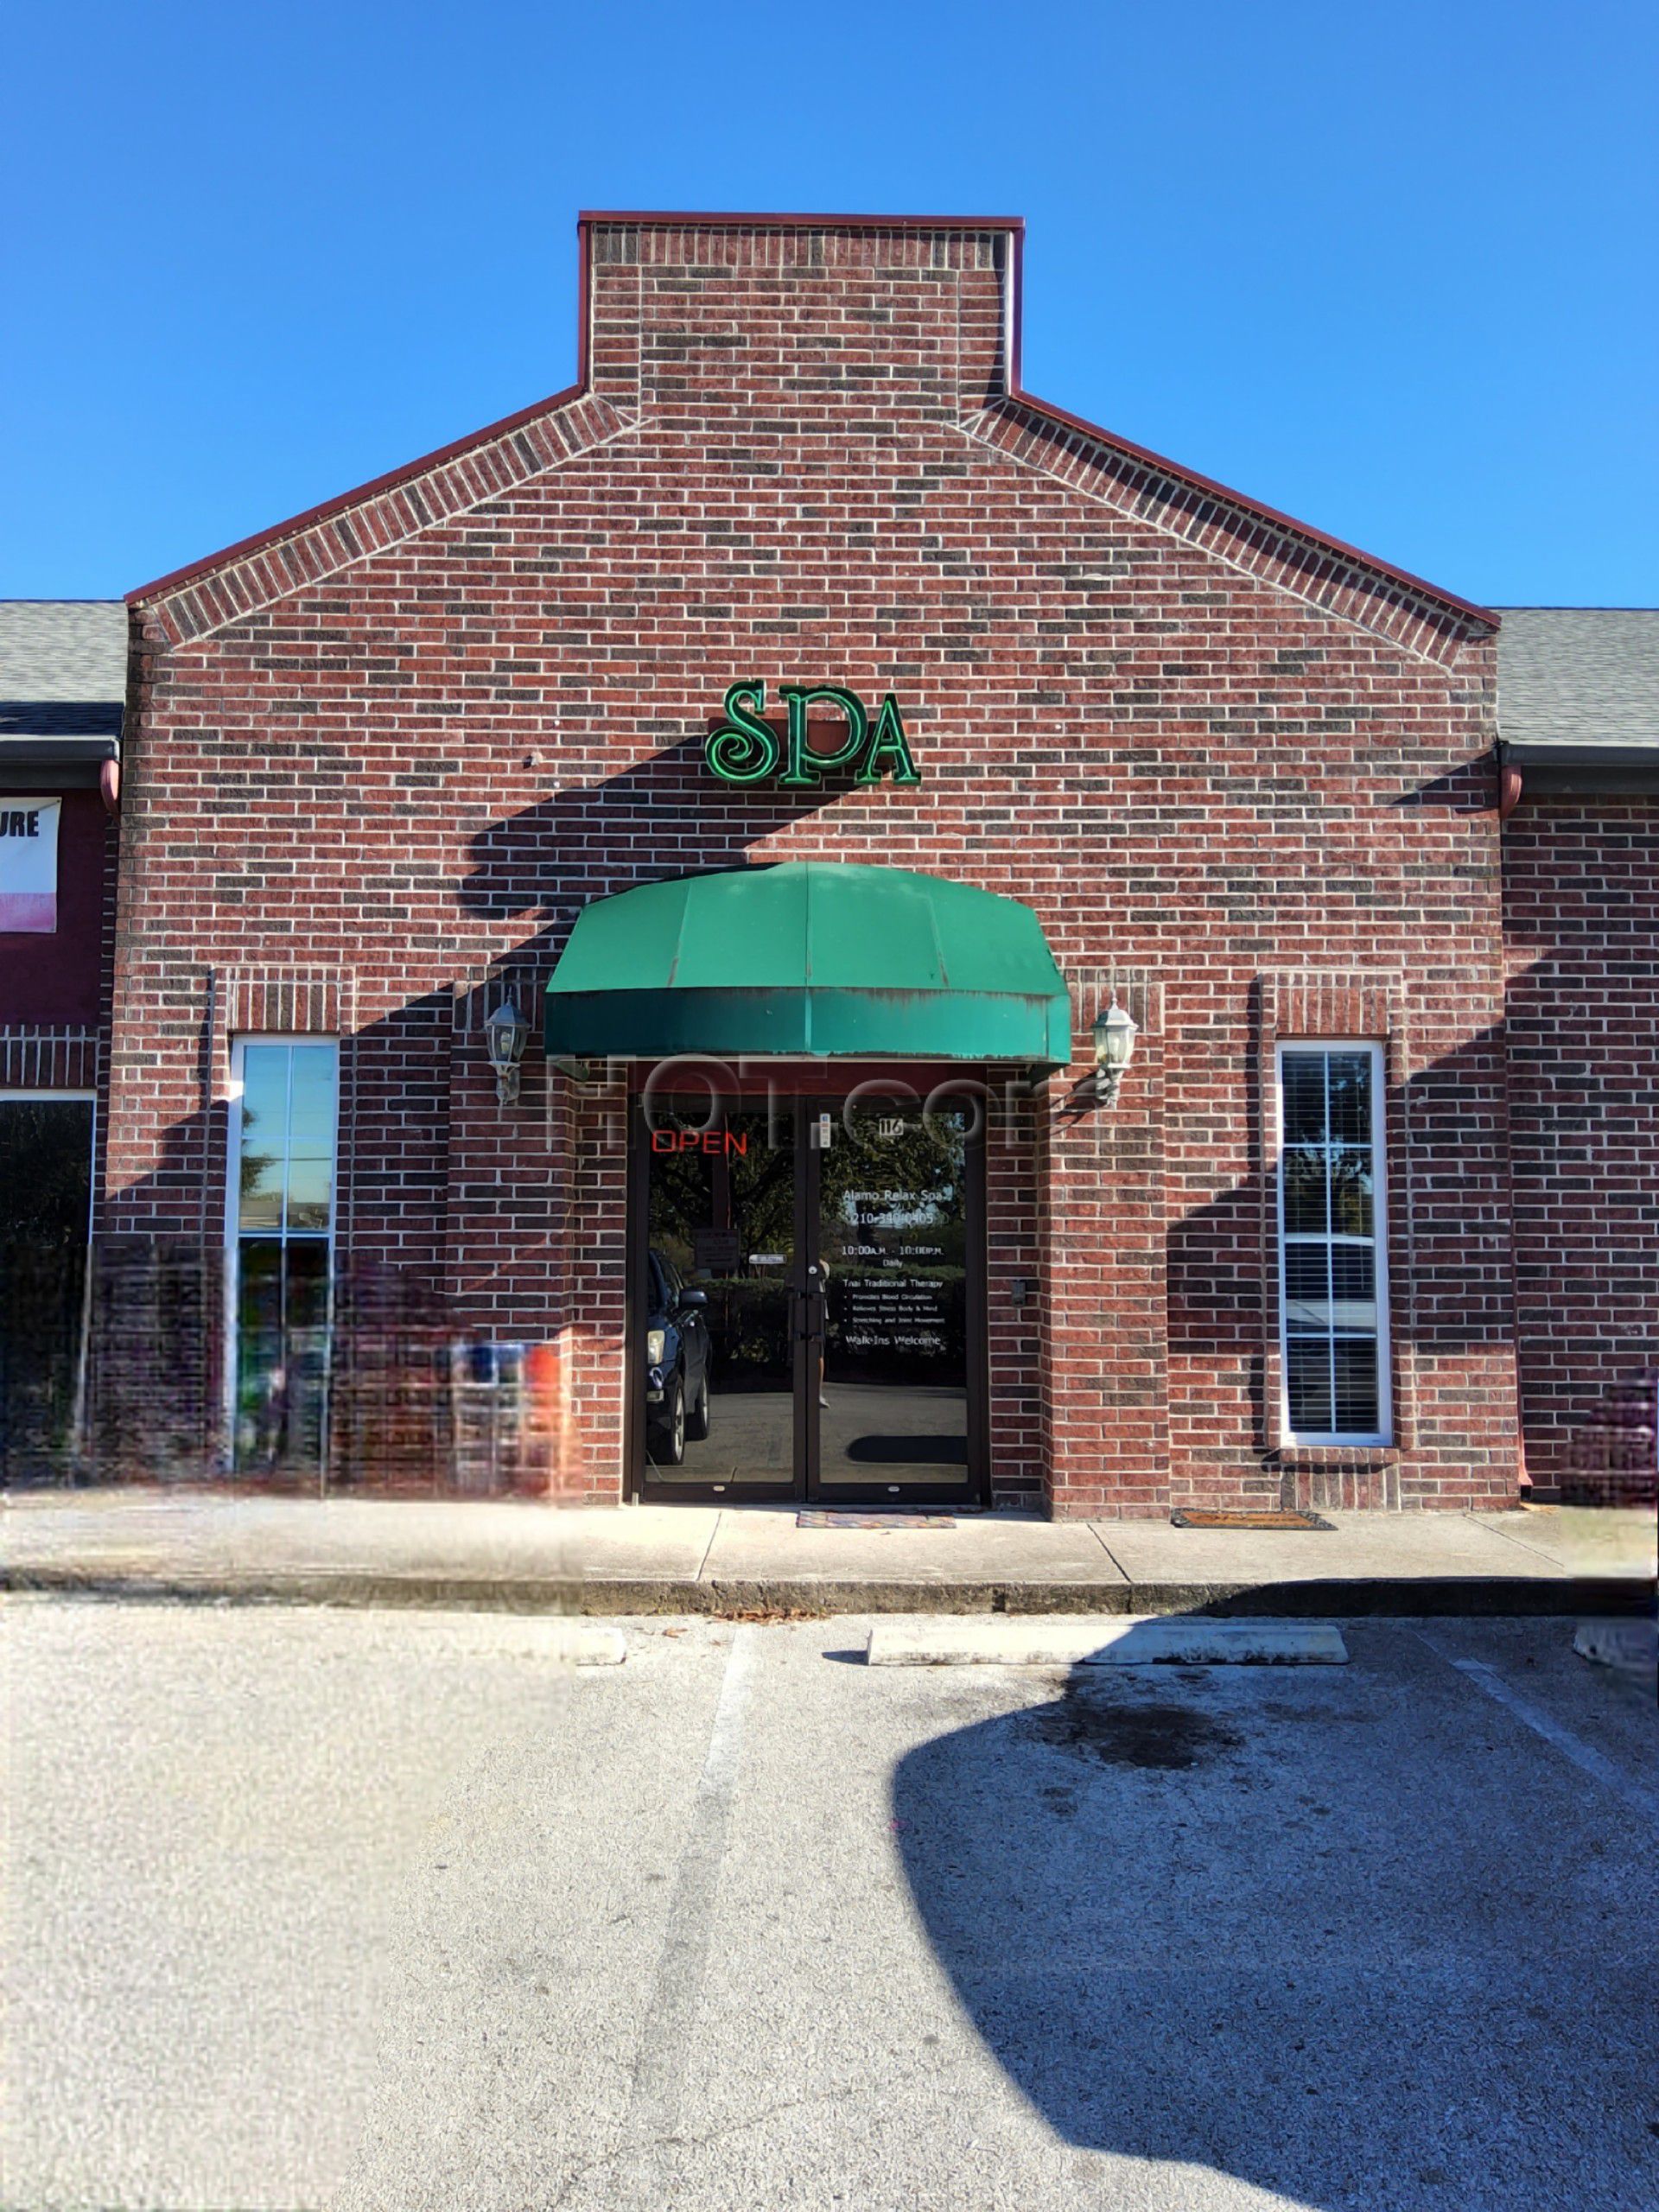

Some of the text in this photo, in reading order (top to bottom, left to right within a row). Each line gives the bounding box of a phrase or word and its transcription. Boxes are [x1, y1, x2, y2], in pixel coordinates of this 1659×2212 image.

[705, 678, 921, 785] SPA
[880, 1119, 902, 1135] 116
[652, 1129, 747, 1155] OPEN
[843, 1189, 943, 1202] Alamo Relax Spa
[882, 1259, 903, 1268] Daily
[865, 1279, 907, 1287] Traditional
[910, 1279, 944, 1288] Therapy
[893, 1335, 941, 1345] Welcome
